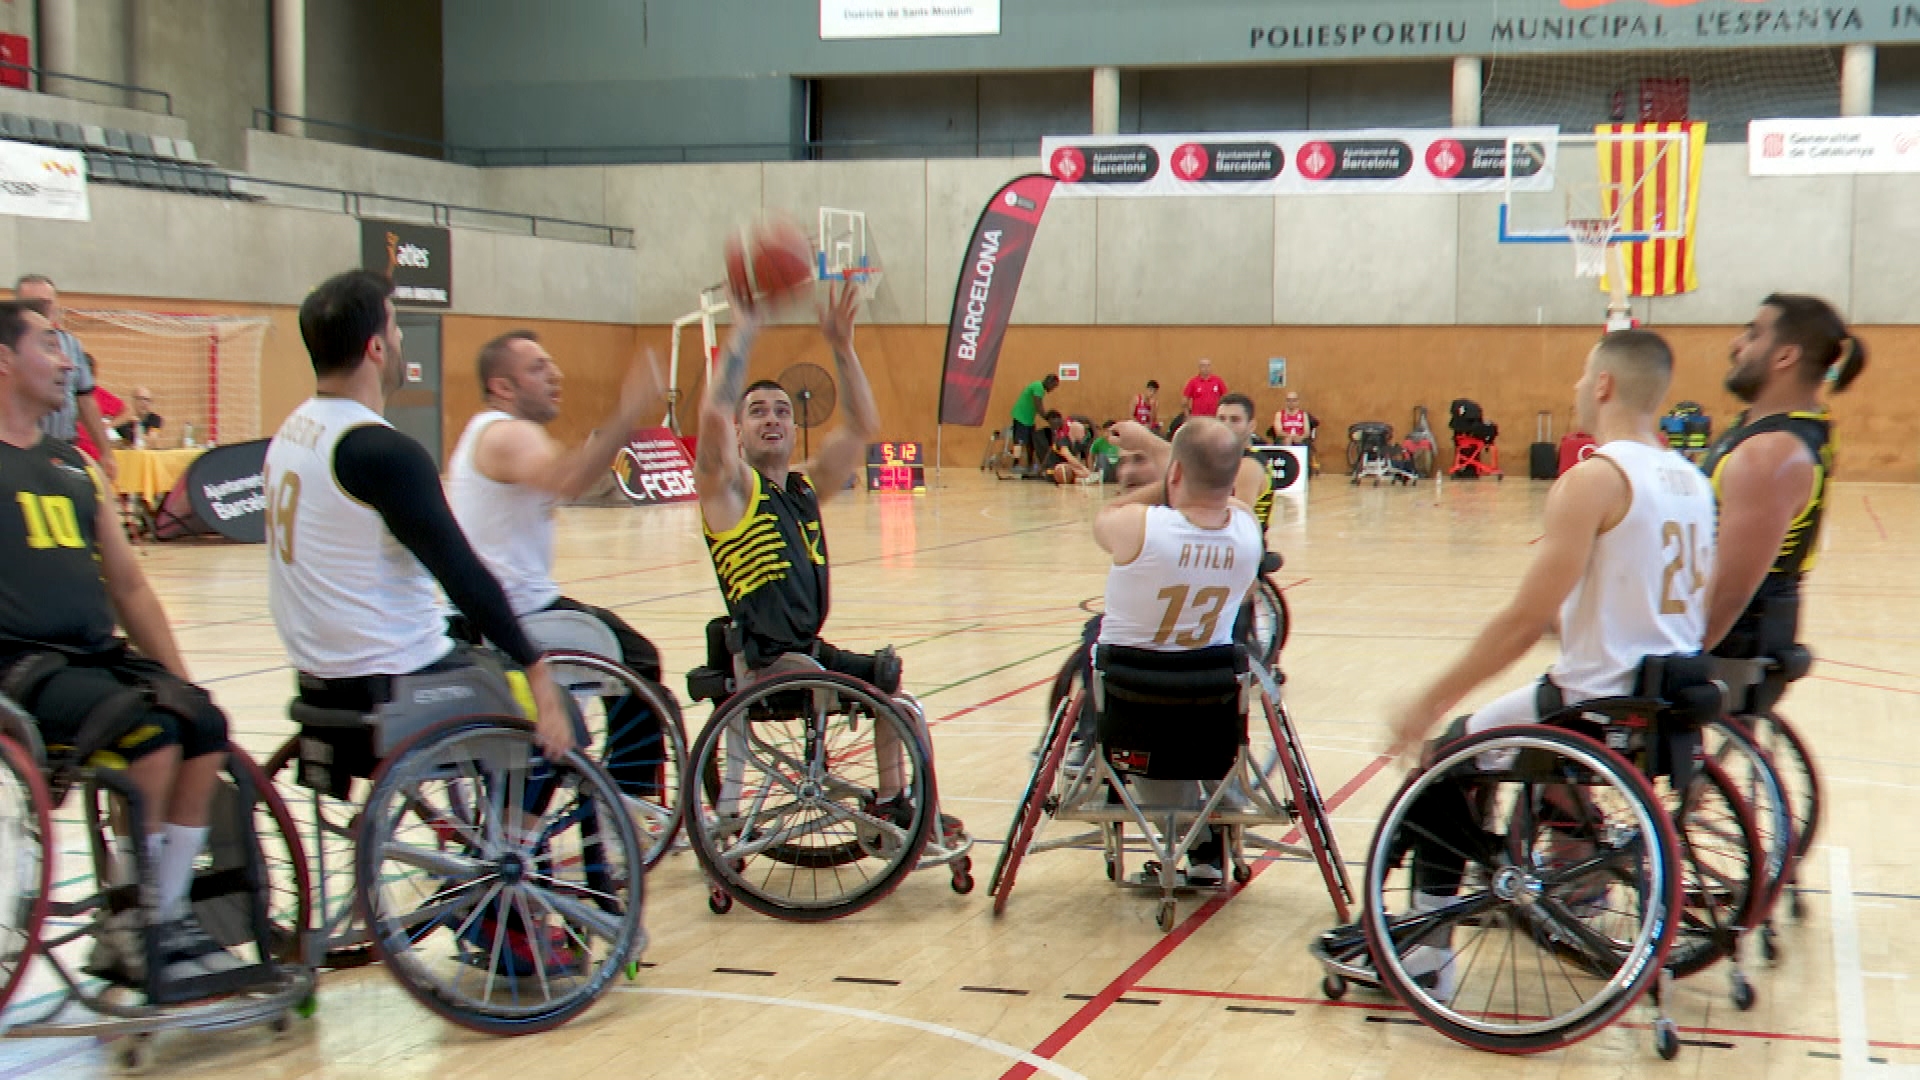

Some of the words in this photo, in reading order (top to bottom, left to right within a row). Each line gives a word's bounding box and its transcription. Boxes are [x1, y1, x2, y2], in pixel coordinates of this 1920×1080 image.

[887, 9, 899, 19] de
[1250, 20, 1467, 48] POLIESPORTIU
[1491, 14, 1668, 42] MUNICIPAL
[1697, 8, 1863, 36] L'ESPANYA
[1789, 132, 1861, 144] Generalitat
[1093, 152, 1135, 163] Ajuntament
[1137, 152, 1147, 161] de
[1216, 151, 1260, 161] Ajuntament
[1261, 150, 1272, 160] de
[1343, 146, 1388, 158] Ajuntament
[1389, 146, 1400, 156] de
[1789, 145, 1806, 158] de
[1809, 145, 1875, 158] Catalunya
[1093, 160, 1147, 174] Barcelona
[1215, 160, 1272, 173] Barcelona
[1342, 156, 1400, 170] Barcelona
[957, 229, 1002, 361] BARCELONA
[16, 491, 88, 549] 10
[1179, 543, 1235, 570] ATILA
[1152, 584, 1231, 648] 13
